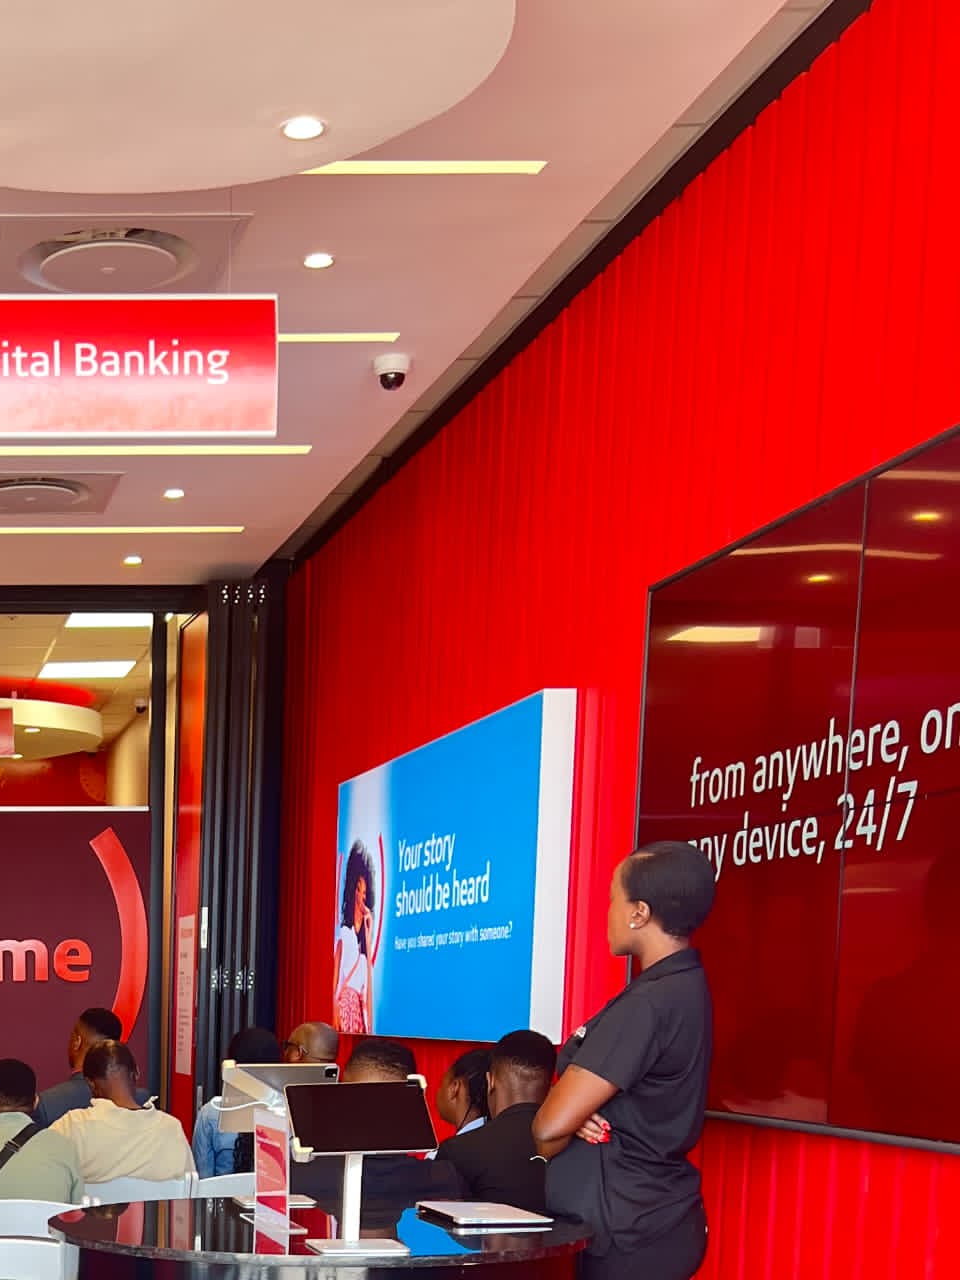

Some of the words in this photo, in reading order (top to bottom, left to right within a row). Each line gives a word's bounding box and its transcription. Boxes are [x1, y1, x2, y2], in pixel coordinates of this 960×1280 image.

[74, 339, 230, 386] Banking
[690, 756, 746, 808] from
[752, 717, 909, 801] anywhere,
[920, 702, 960, 755] on
[398, 839, 424, 873] Your
[423, 832, 456, 872] story
[687, 833, 728, 883] ny
[733, 803, 826, 865] device,
[834, 776, 919, 851] 24/7
[395, 873, 433, 918] should
[435, 872, 451, 911] be
[452, 860, 491, 907] heard
[406, 936, 417, 953] you
[417, 931, 436, 949] shared
[435, 932, 449, 951] your
[448, 929, 465, 949] story
[465, 923, 479, 943] with
[479, 920, 513, 942] someone?
